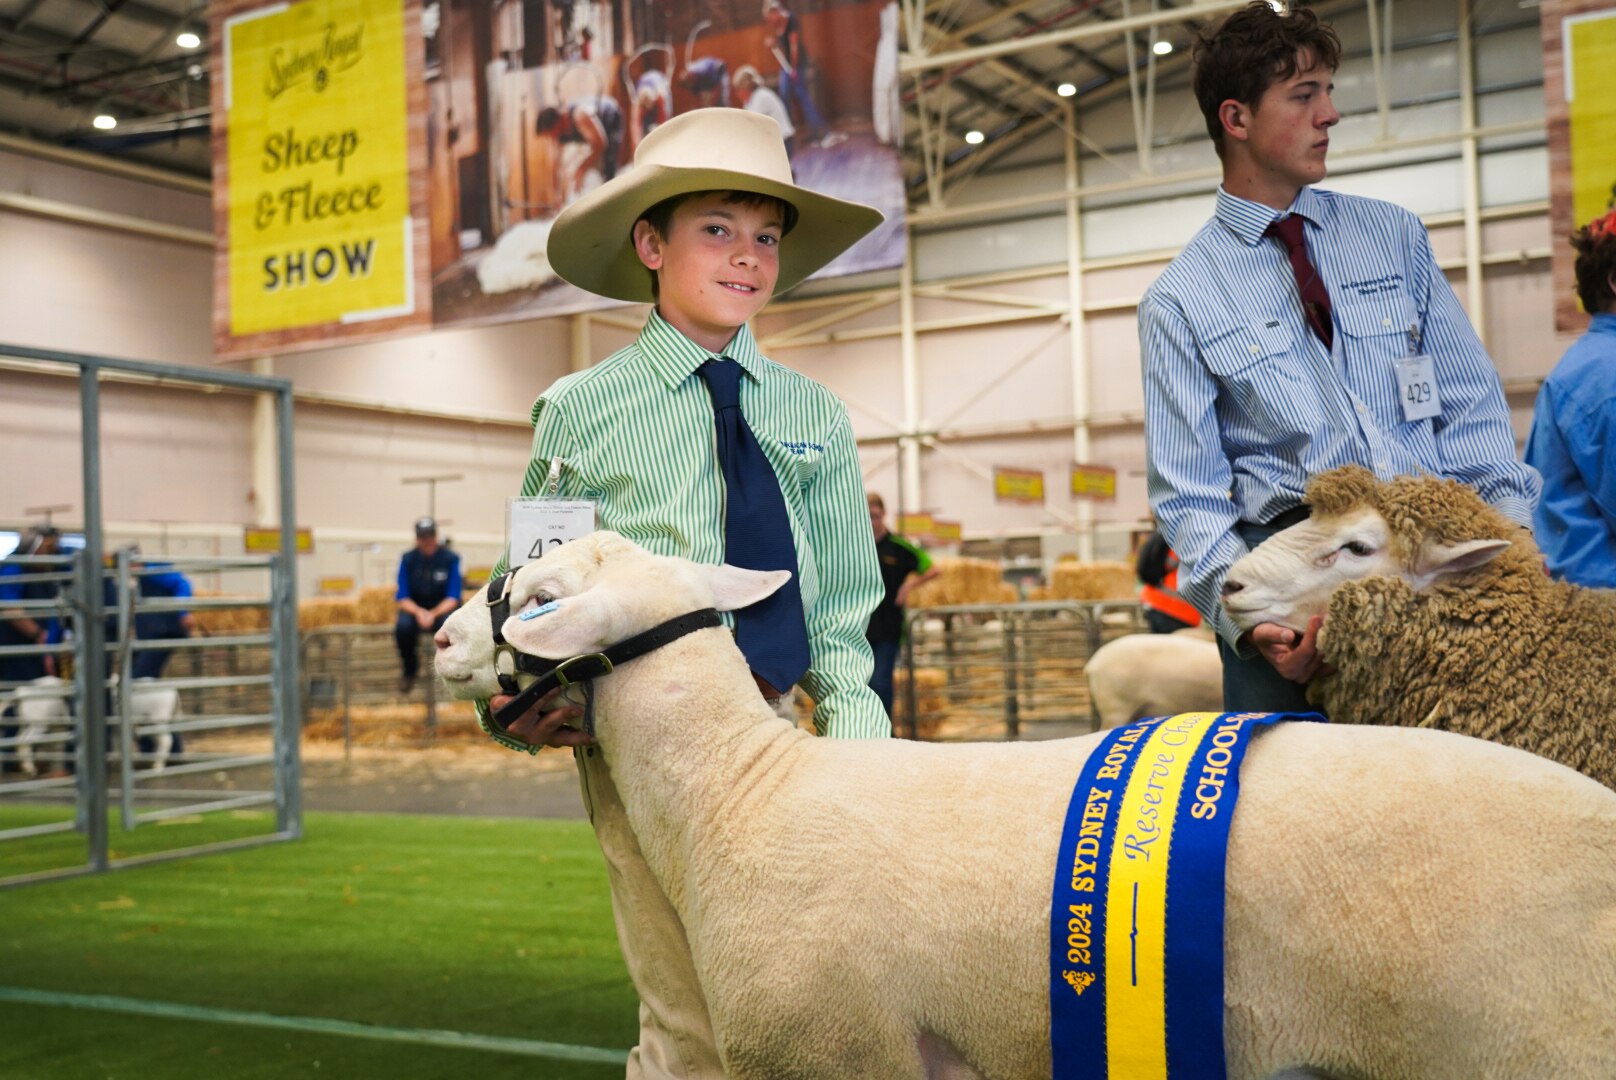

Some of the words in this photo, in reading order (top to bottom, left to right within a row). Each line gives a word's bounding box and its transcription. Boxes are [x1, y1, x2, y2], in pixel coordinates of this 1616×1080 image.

[262, 127, 359, 175] Sheep
[263, 239, 376, 290] SHOW
[1407, 382, 1431, 404] 429
[1096, 725, 1150, 780] ROYAL
[1124, 753, 1175, 862] Reserve
[1071, 787, 1112, 892] SYDNEY
[1067, 902, 1093, 964] 2024
